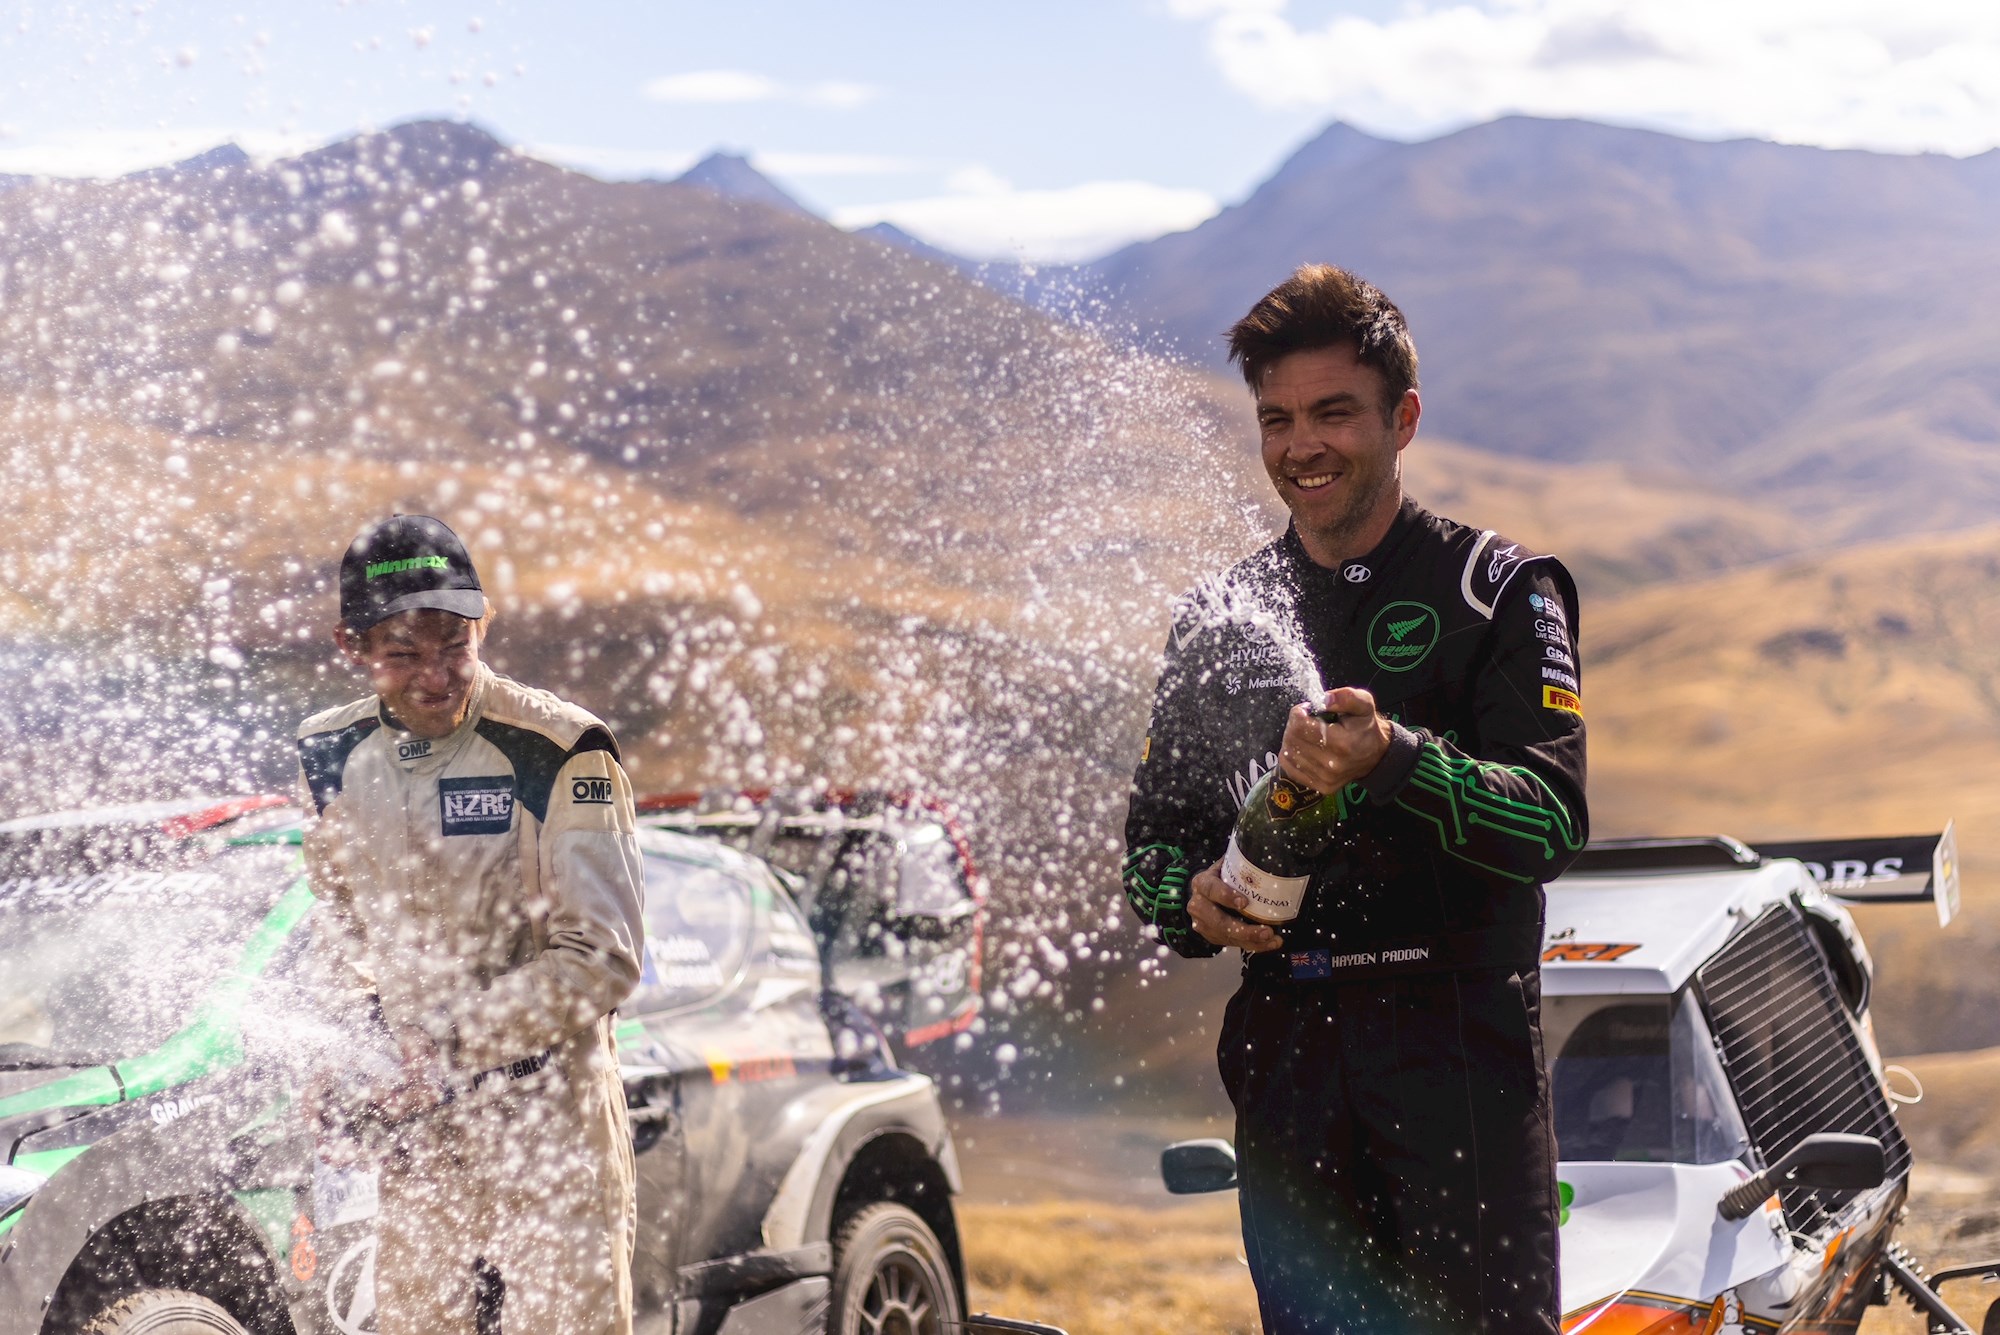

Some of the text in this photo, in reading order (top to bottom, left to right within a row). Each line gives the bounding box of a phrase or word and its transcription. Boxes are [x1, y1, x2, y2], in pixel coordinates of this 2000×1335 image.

[366, 555, 448, 580] winmax
[399, 741, 431, 758] OMP
[573, 781, 611, 799] OMP
[444, 793, 511, 817] NZRC
[1251, 891, 1290, 907] VERNAY
[1332, 948, 1429, 967] HAYDEN PADDON
